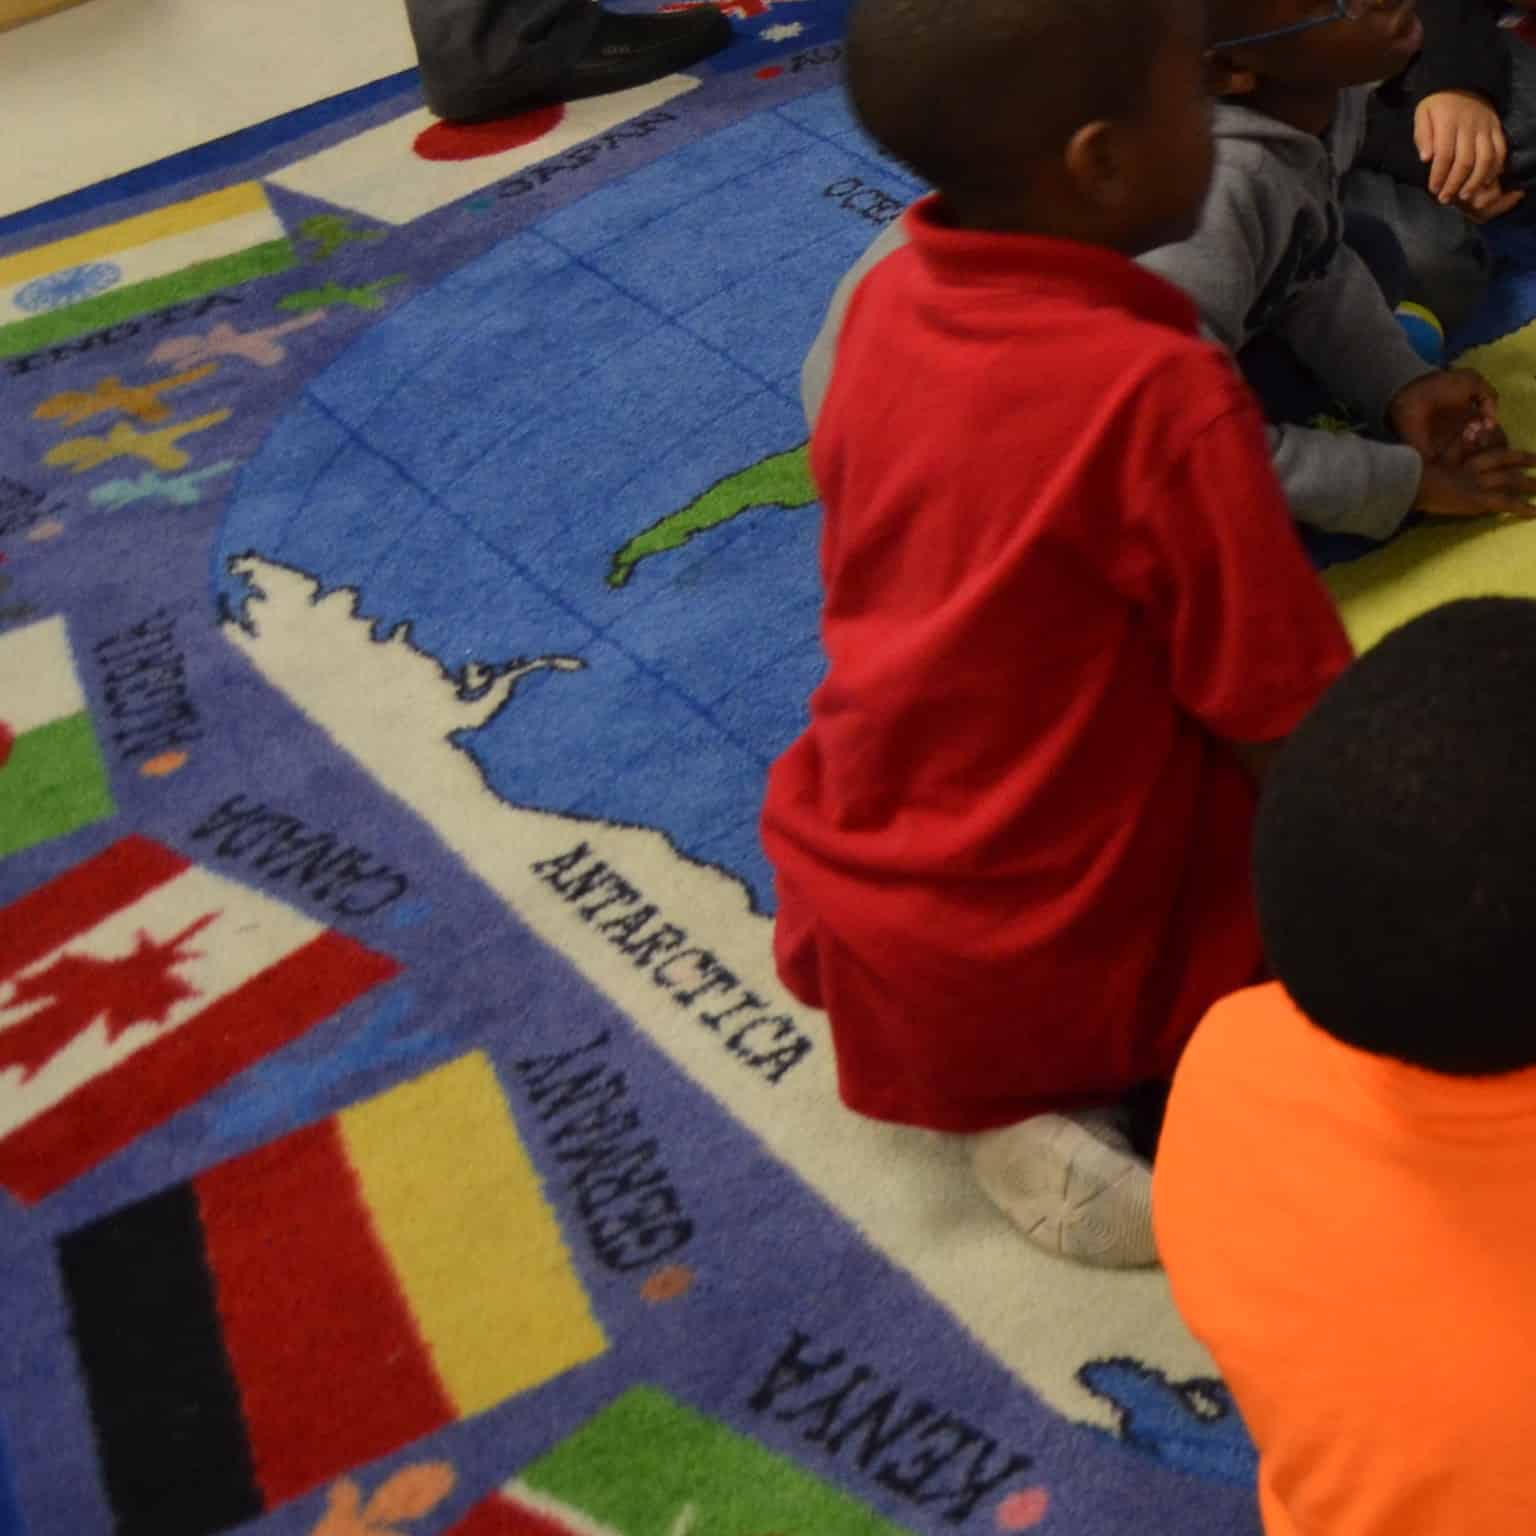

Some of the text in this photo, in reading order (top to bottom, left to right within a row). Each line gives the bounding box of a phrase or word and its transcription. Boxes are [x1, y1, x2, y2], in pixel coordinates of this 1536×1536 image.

[499, 110, 677, 200] JAPAN
[2, 294, 246, 378] INDIA
[190, 792, 411, 924] CANADA
[530, 842, 816, 1088] ANTARCTICA
[514, 1030, 697, 1276] GERMANY
[744, 1329, 1036, 1528] KENYA
